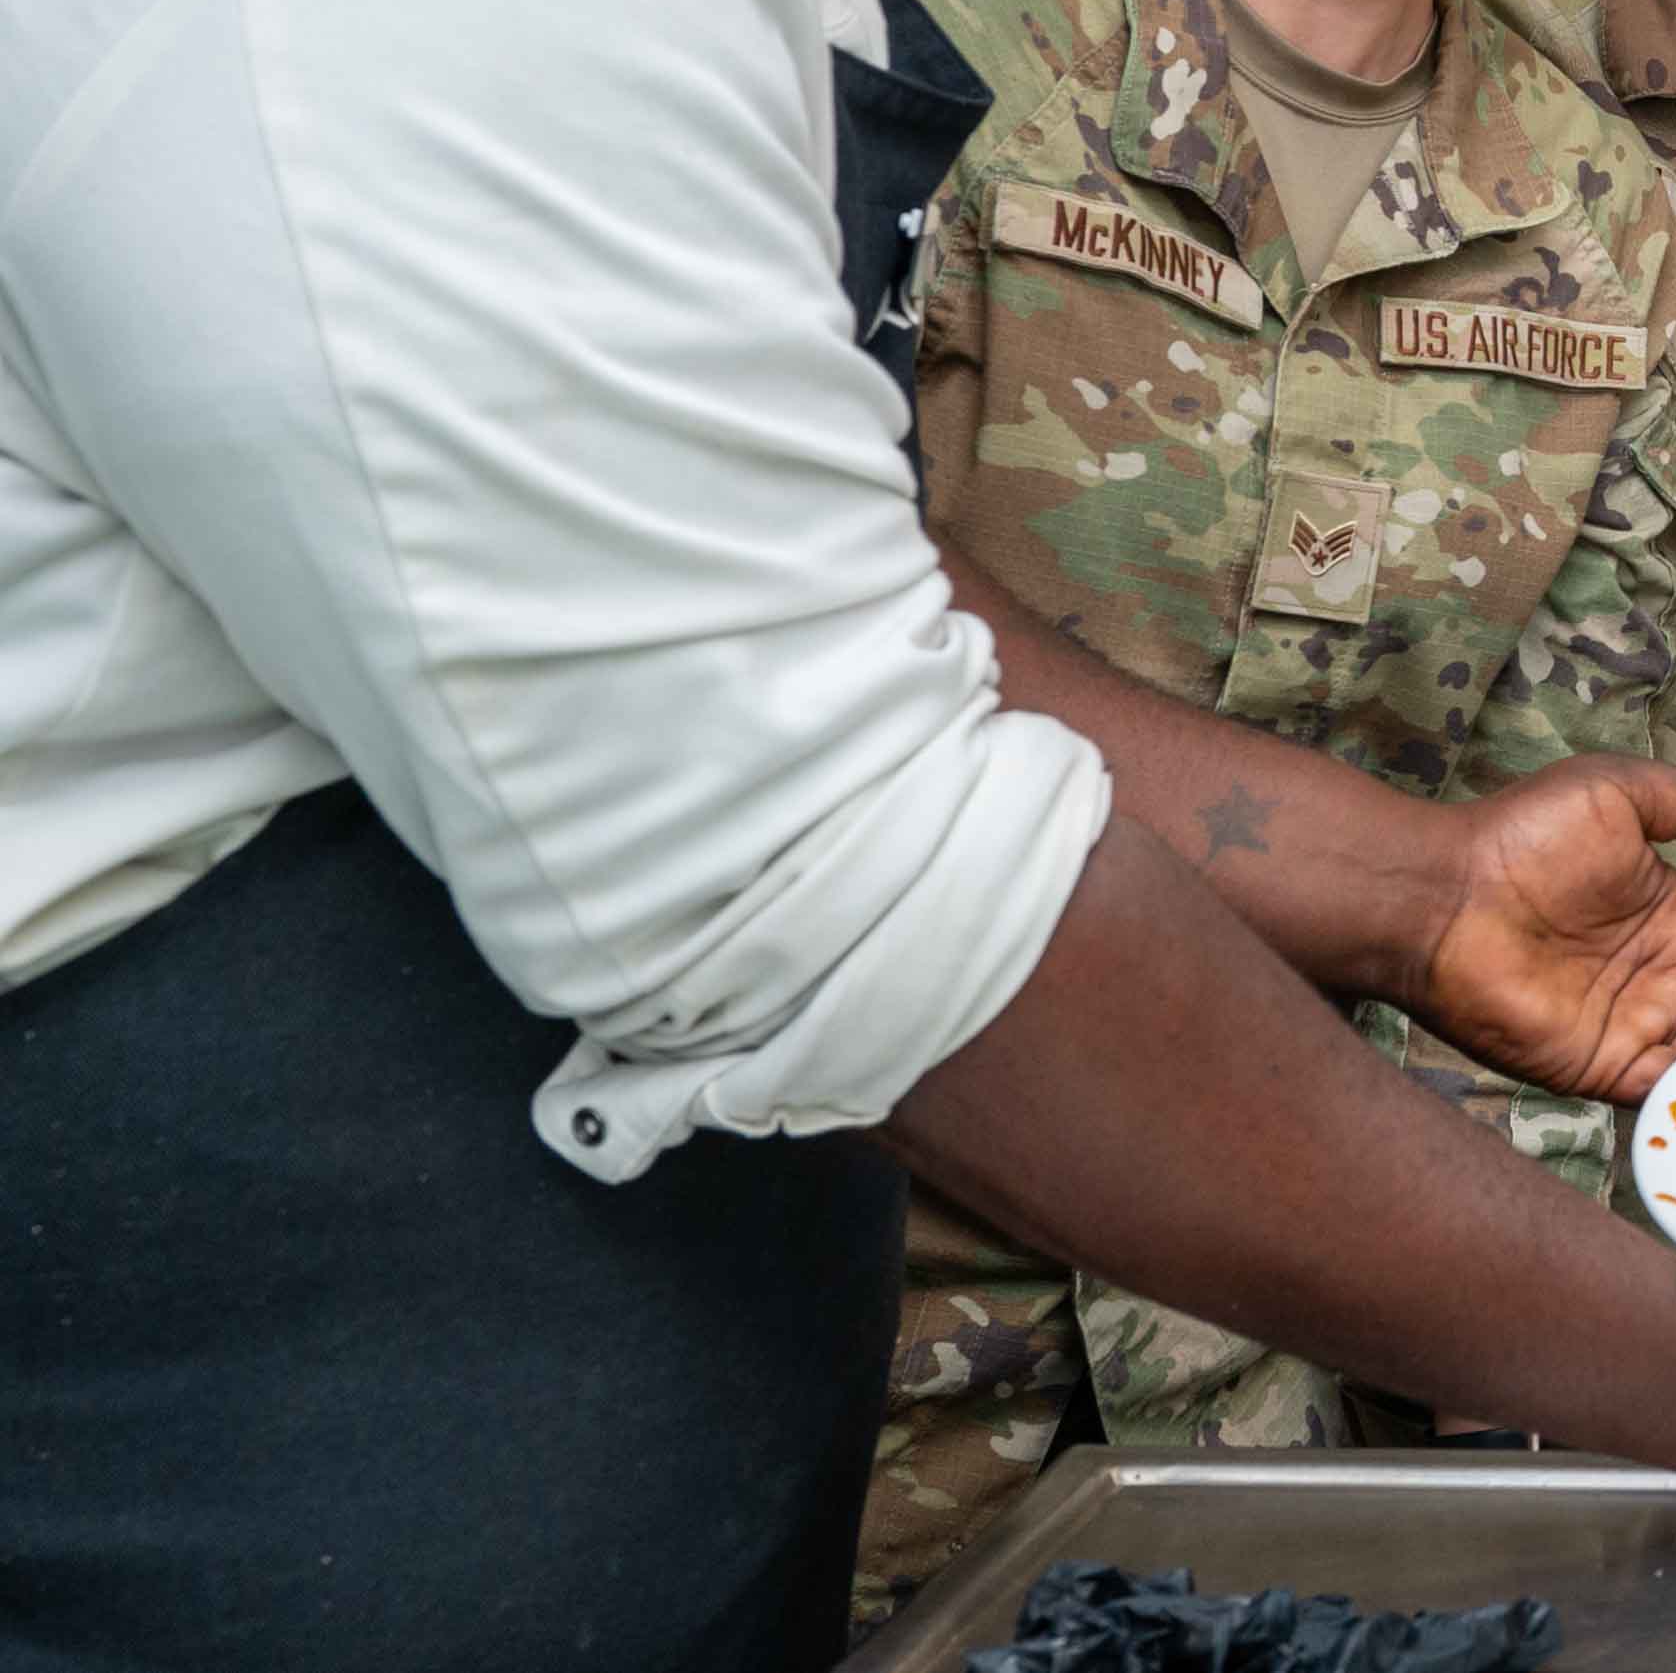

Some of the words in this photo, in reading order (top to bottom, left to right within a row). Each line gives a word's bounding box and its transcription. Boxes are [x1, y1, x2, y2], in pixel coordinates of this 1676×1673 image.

[1050, 198, 1225, 305] McKINNEY
[1393, 307, 1456, 361] U.S.
[1466, 315, 1521, 370] AIR
[1526, 323, 1629, 382] FORCE
